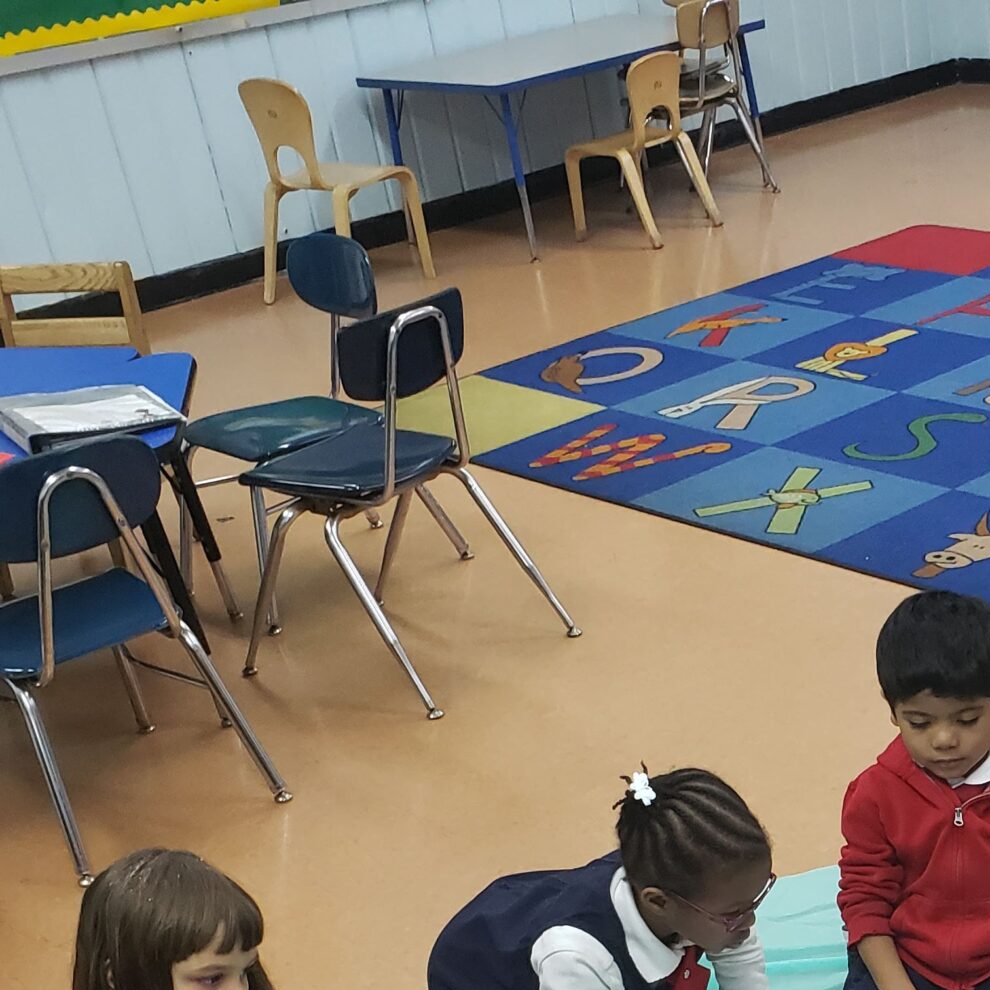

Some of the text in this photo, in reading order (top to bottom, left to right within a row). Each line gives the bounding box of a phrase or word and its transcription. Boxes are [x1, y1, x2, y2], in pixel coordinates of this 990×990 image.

[664, 303, 787, 348] K
[656, 375, 816, 431] R
[842, 412, 988, 462] S
[528, 423, 732, 481] W
[694, 466, 874, 535] X
